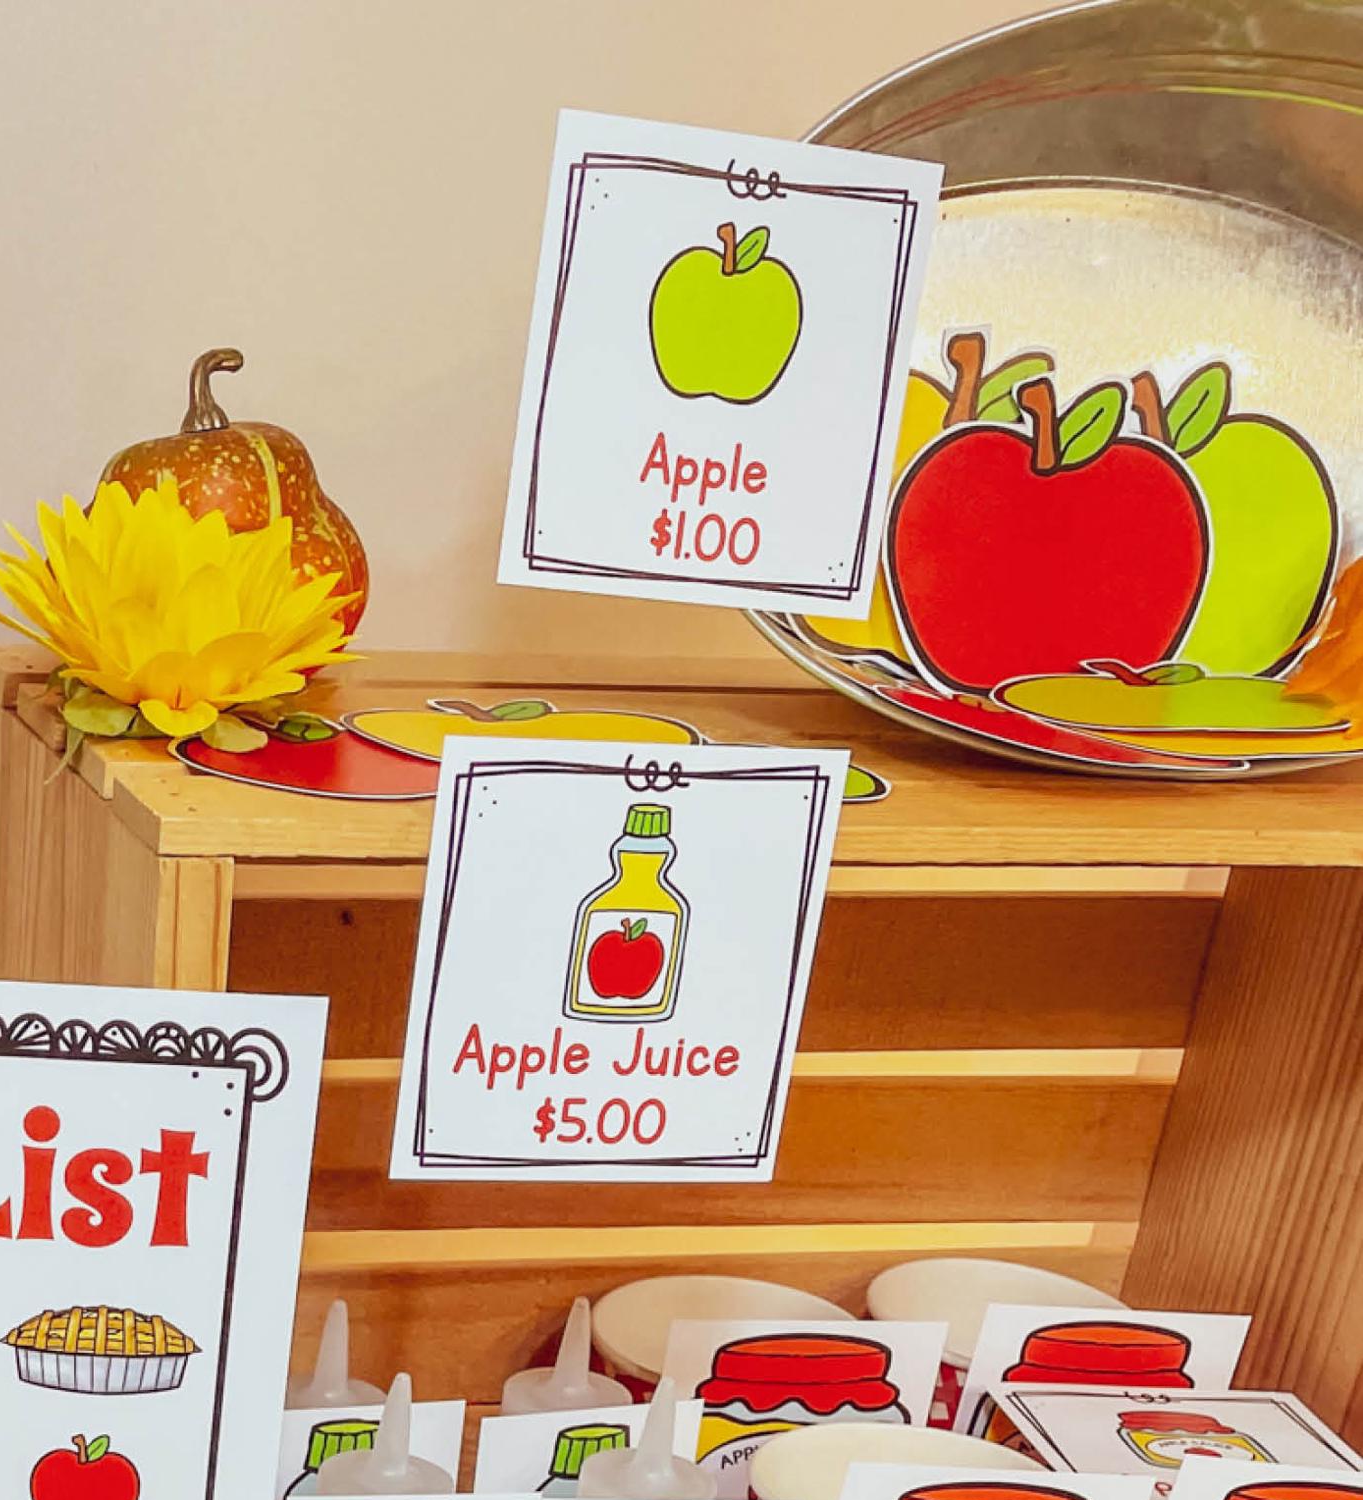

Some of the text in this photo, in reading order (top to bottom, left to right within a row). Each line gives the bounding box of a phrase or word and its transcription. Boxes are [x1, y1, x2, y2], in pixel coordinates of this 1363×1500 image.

[640, 432, 767, 505] Apple
[650, 509, 761, 565] $1.00
[453, 1023, 740, 1090] Apple Juice
[533, 1097, 667, 1144] $5.00
